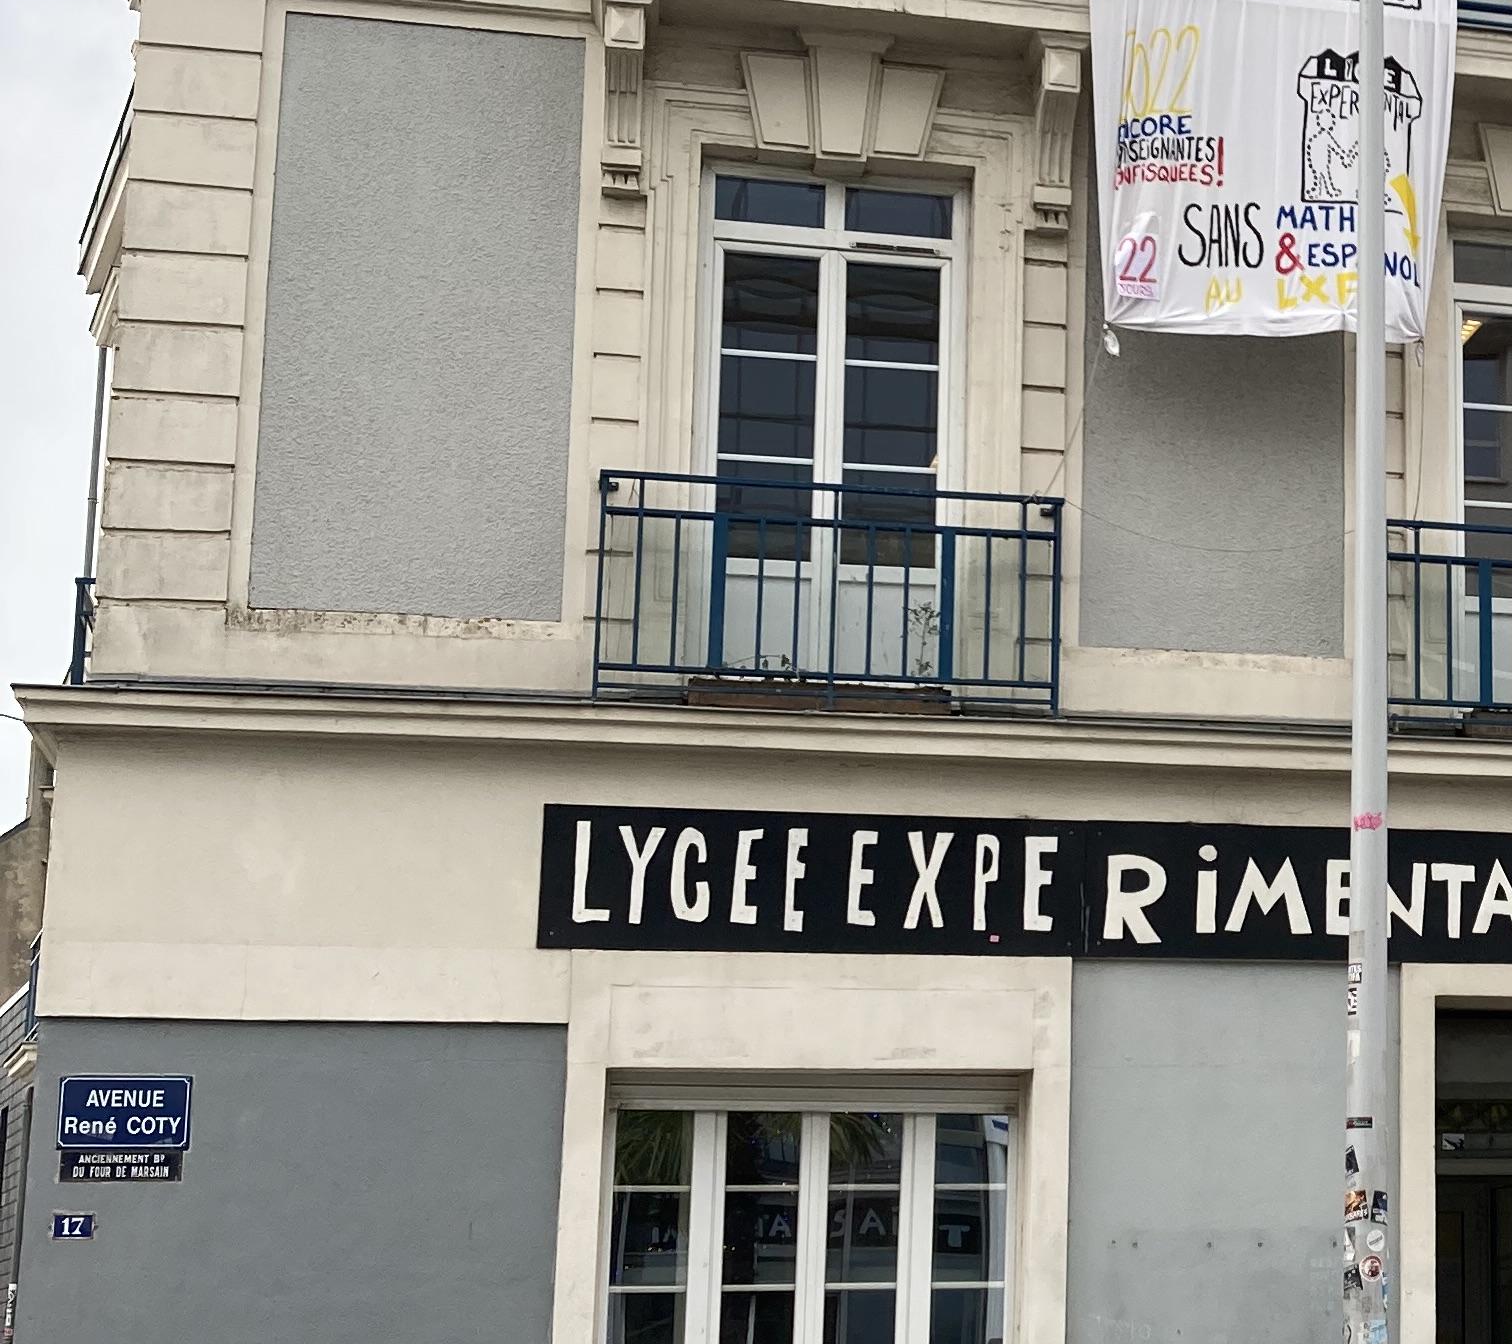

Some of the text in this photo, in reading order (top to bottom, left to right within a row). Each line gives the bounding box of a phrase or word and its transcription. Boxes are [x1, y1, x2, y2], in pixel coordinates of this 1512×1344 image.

[1178, 202, 1265, 268] SANS
[1117, 235, 1157, 283] 22
[1275, 232, 1420, 289] & ESPNOL
[1205, 274, 1243, 316] AU
[86, 1089, 165, 1107] AVENUE
[64, 1116, 182, 1135] René COTY
[78, 1154, 149, 1164] ANCIENNEMENT
[72, 1166, 170, 1178] DU FOUR DE MARSAIN
[61, 1217, 85, 1236] 17
